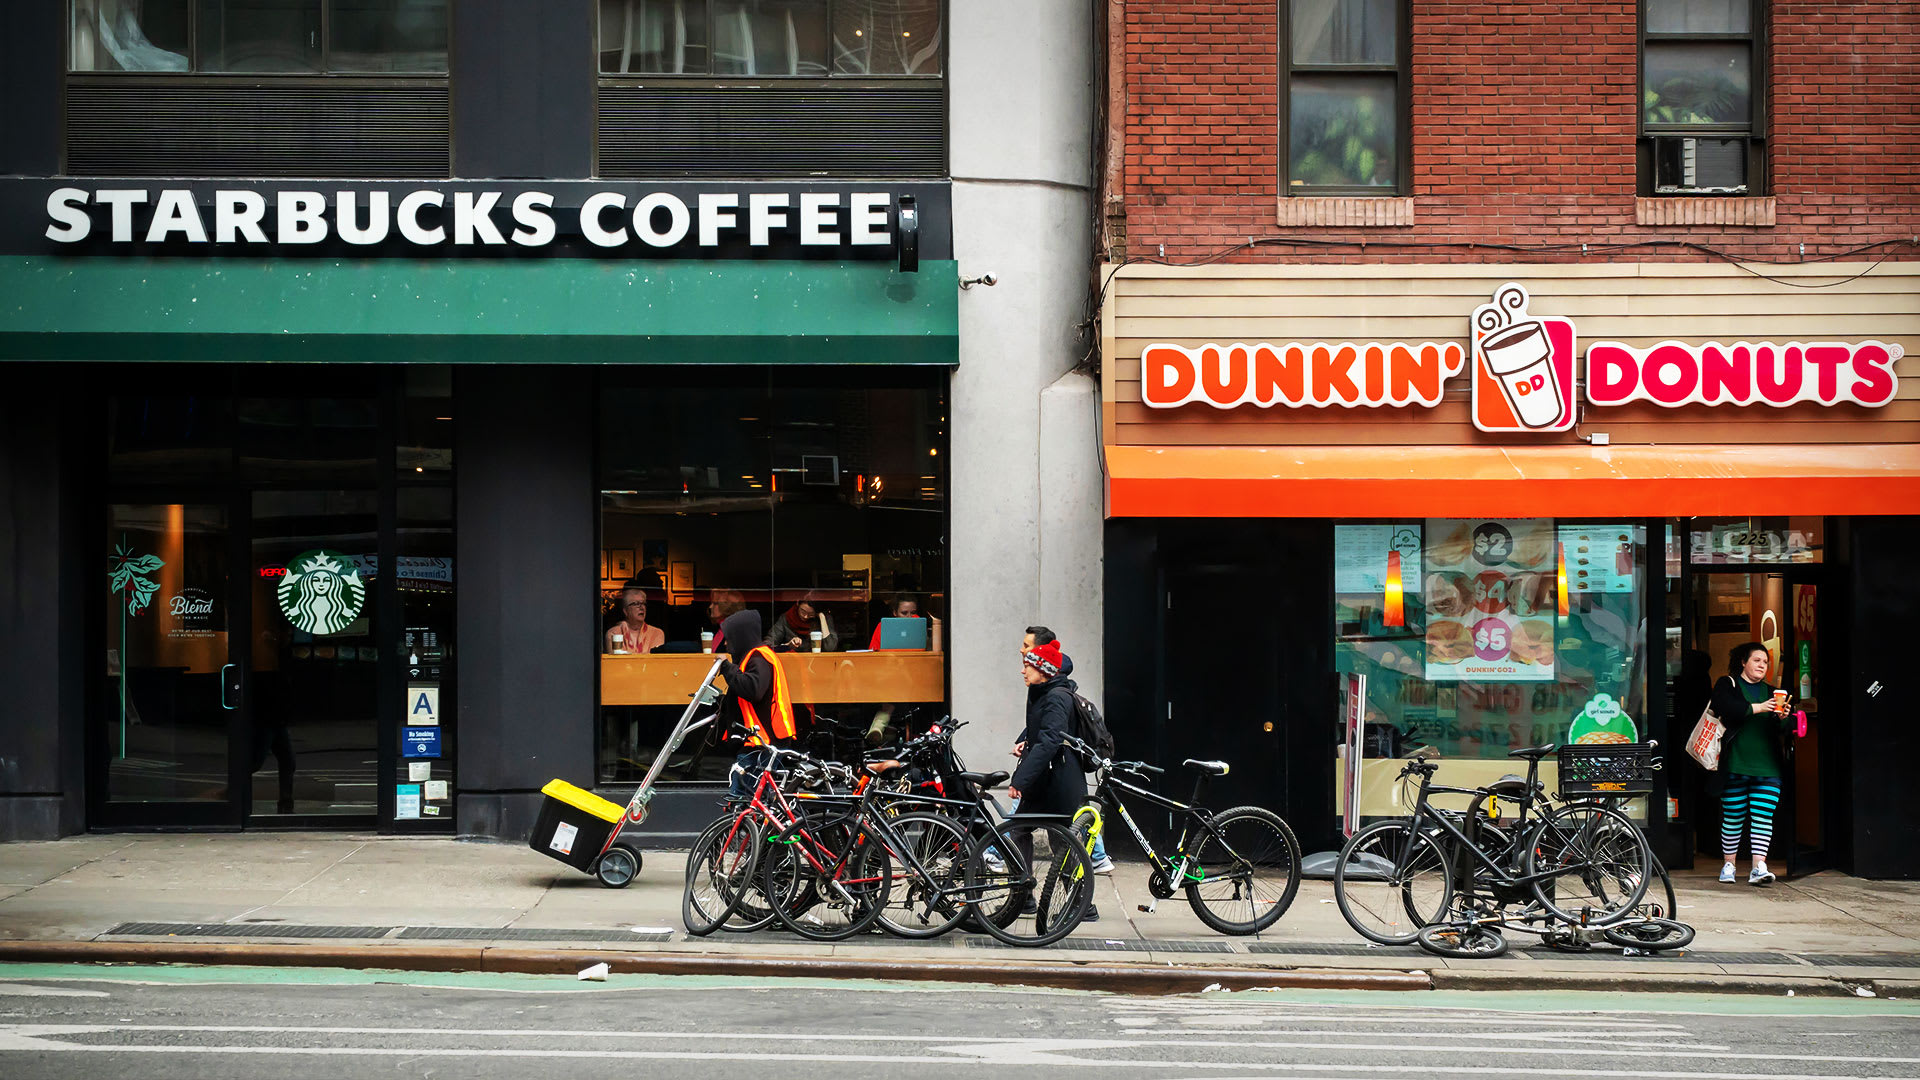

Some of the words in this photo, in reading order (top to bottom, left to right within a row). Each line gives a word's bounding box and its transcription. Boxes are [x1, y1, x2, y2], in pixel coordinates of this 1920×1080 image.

[45, 187, 557, 247] STARBUCKS
[579, 191, 892, 247] COFFEE
[1146, 345, 1461, 404] DUNKIN'
[1515, 374, 1545, 397] DD
[1590, 345, 1894, 404] DONUTS
[1475, 532, 1507, 556] $2
[1738, 532, 1768, 546] 225
[1475, 580, 1505, 603] $4
[169, 596, 214, 615] Blend
[1800, 594, 1815, 633] $5
[1475, 627, 1507, 651] $5
[413, 692, 433, 715] A
